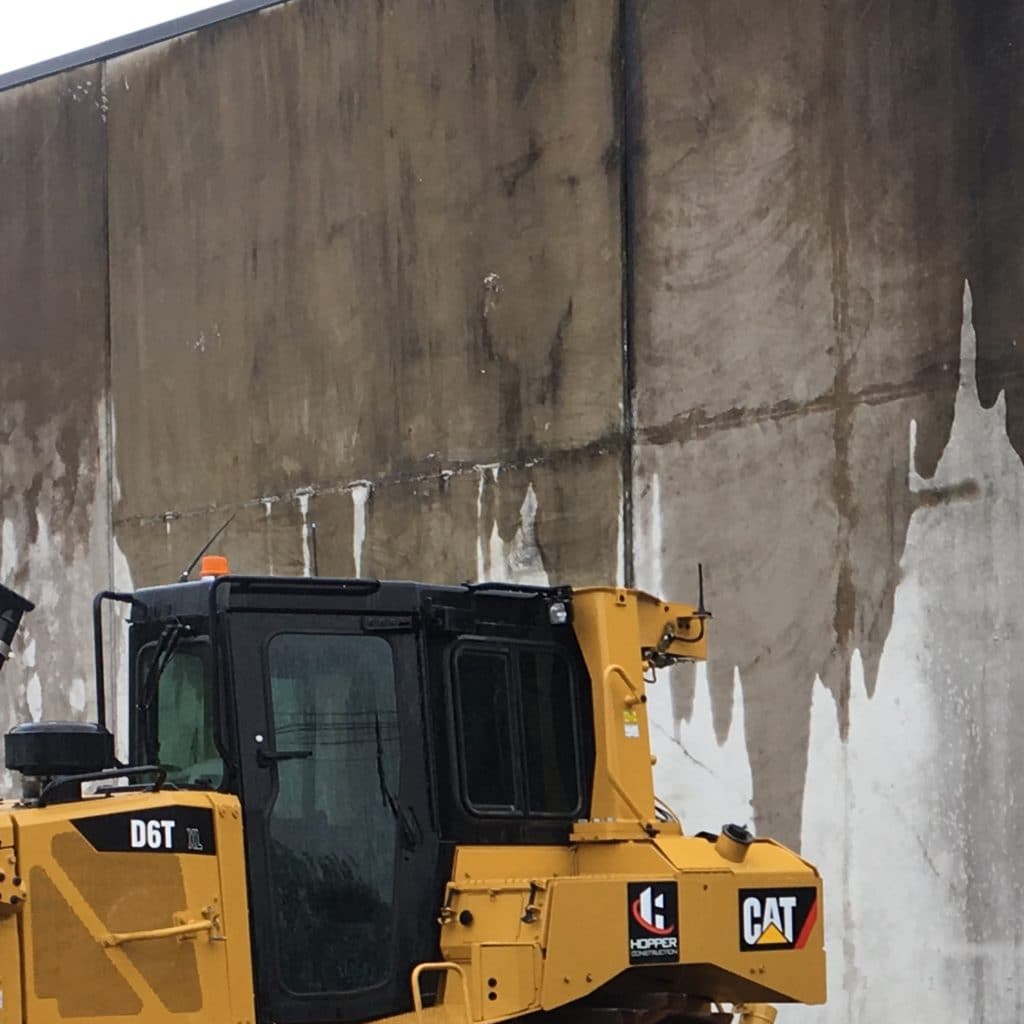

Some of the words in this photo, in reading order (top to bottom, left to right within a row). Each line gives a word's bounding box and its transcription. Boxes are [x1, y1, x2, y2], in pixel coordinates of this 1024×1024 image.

[130, 819, 175, 849] D6T
[743, 896, 797, 946] CAT
[630, 937, 677, 949] HOPPER
[631, 949, 678, 957] CONSTRUCTION
